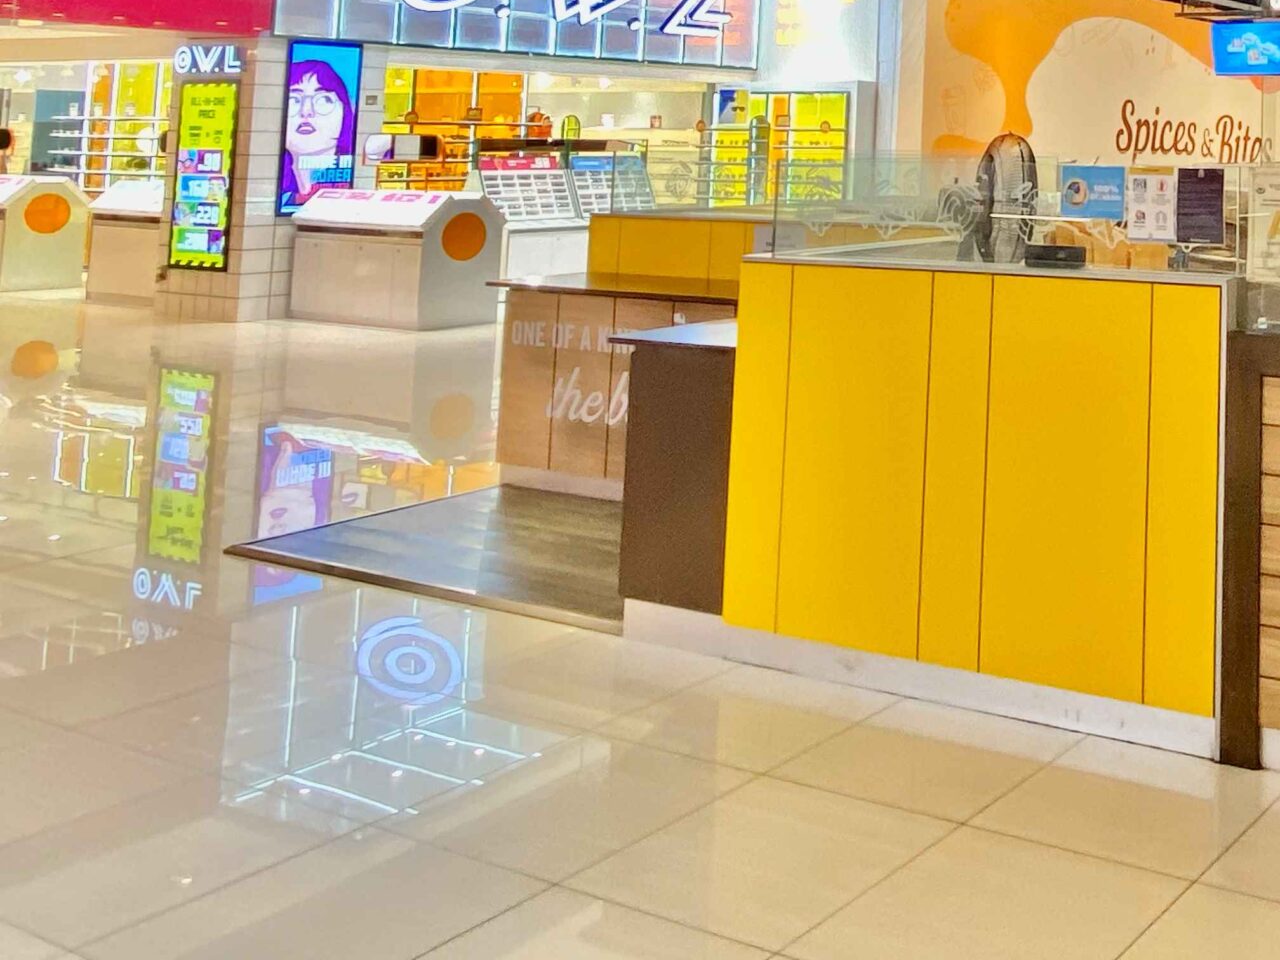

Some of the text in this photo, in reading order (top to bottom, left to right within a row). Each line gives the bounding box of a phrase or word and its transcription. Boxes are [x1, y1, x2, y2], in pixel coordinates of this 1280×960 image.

[1116, 99, 1197, 164] Spices
[1201, 128, 1214, 158] &
[512, 320, 546, 348] ONE
[552, 323, 576, 349] OF
[580, 327, 592, 352] A
[546, 367, 604, 424] the
